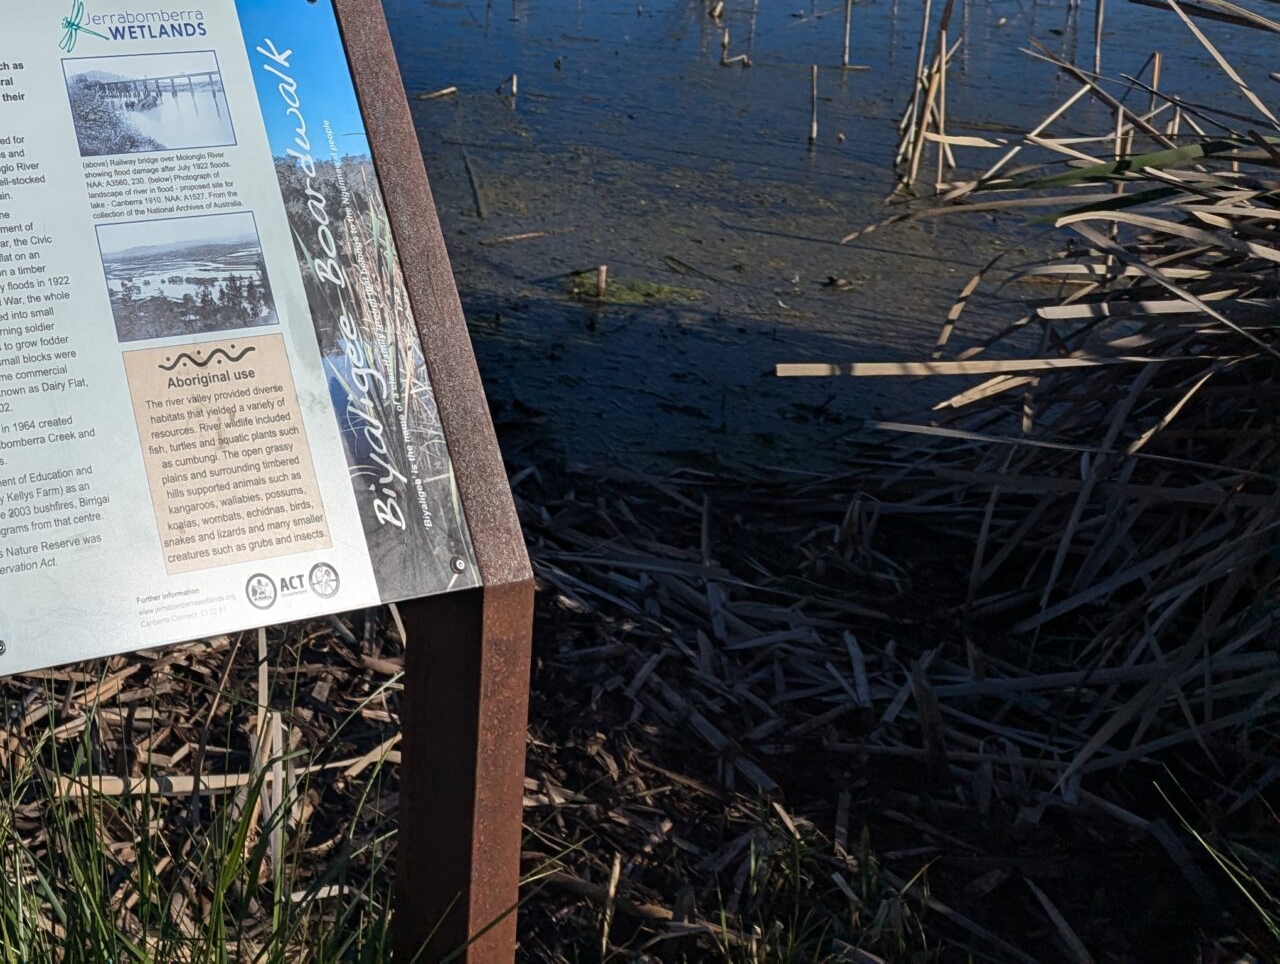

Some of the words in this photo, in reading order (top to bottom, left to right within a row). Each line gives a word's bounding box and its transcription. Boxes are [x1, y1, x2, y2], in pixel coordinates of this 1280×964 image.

[84, 8, 205, 26] Jerrabomberra
[107, 21, 208, 41] WETLANDS
[12, 62, 25, 70] as
[323, 120, 336, 151] people
[84, 171, 113, 179] showing
[113, 168, 131, 176] flood
[131, 167, 160, 175] damage
[160, 165, 176, 173] after
[177, 164, 191, 172] July
[192, 162, 209, 170] 1922
[209, 161, 232, 169] floods.
[256, 38, 345, 289] Boardwalk
[24, 221, 34, 232] of
[167, 369, 231, 390] Aboriginal
[233, 369, 256, 381] use
[1, 424, 11, 434] in
[12, 420, 36, 433] 1964
[38, 415, 73, 429] created
[339, 312, 408, 531] Biyaligee
[406, 445, 415, 461] the
[161, 473, 189, 487] plains
[190, 468, 208, 480] and
[208, 462, 261, 477] surrounding
[262, 455, 301, 470] timbered
[411, 464, 419, 473] is
[167, 500, 218, 515] kangaroos,
[219, 493, 264, 507] wallabies,
[264, 487, 307, 502] possums,
[40, 557, 59, 568] Act.
[279, 573, 306, 593] ACT
[136, 595, 161, 604] Further
[162, 588, 200, 600] information
